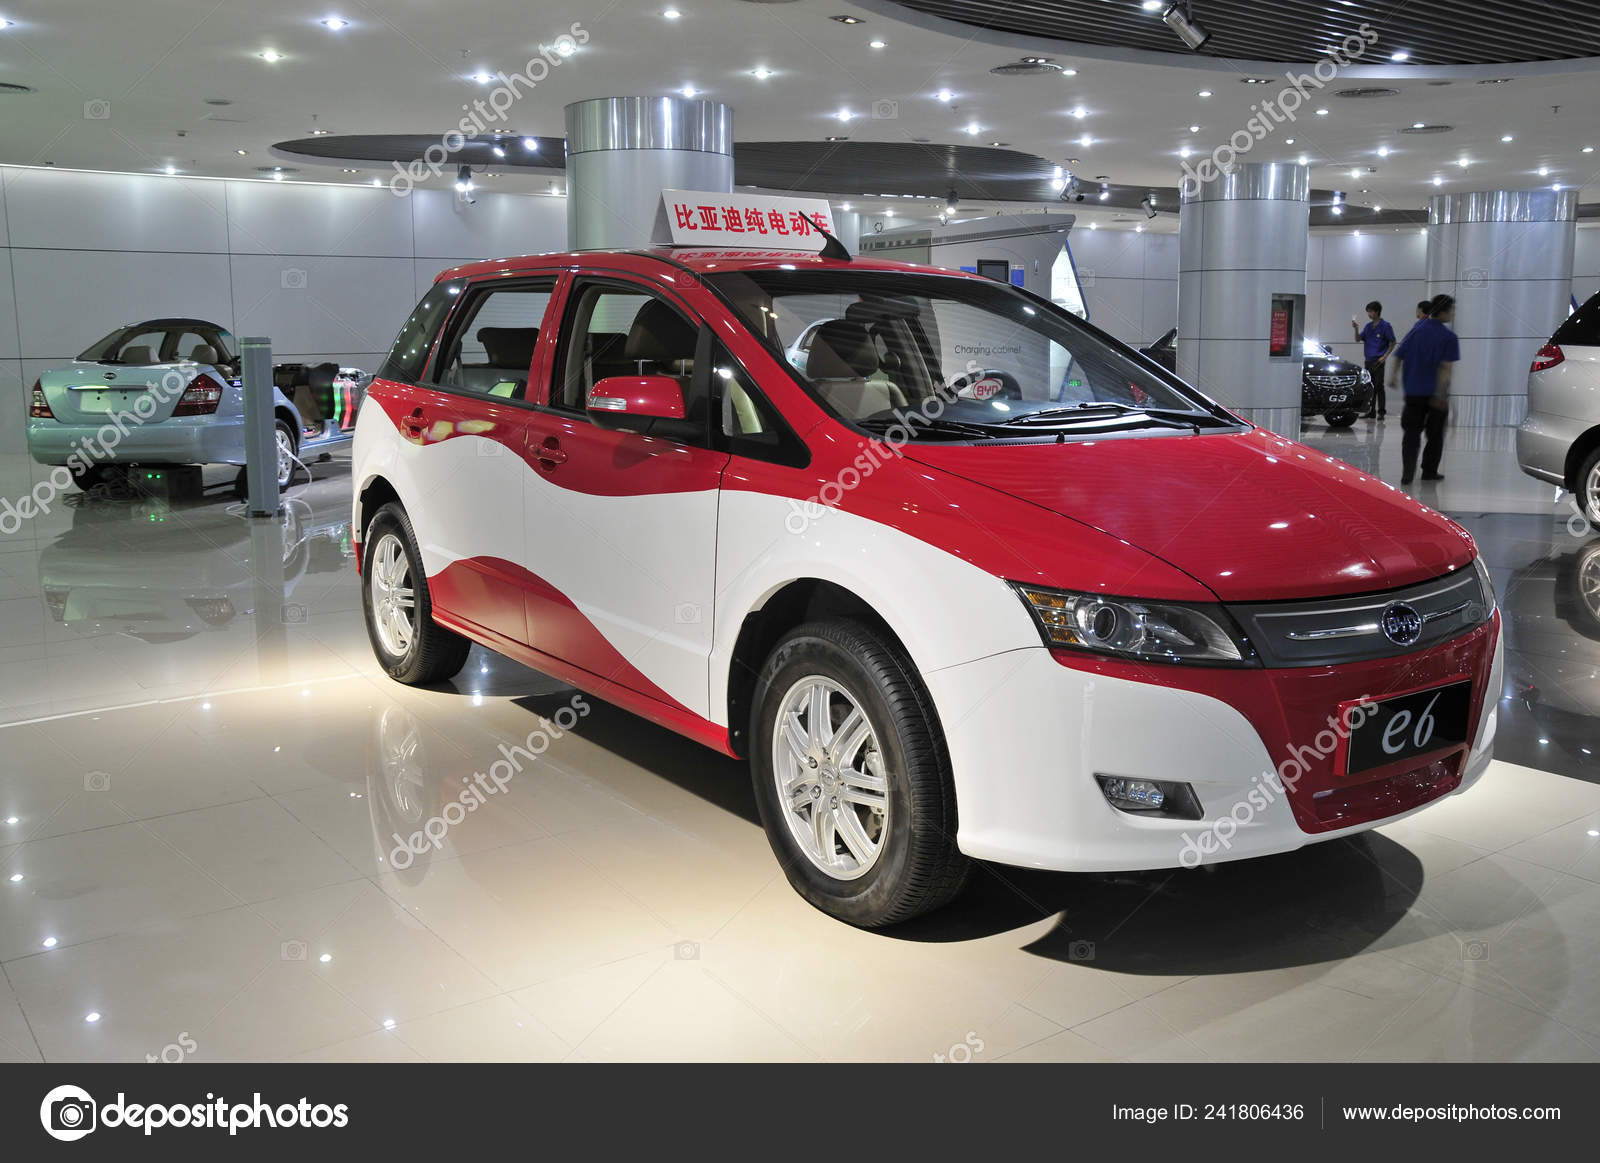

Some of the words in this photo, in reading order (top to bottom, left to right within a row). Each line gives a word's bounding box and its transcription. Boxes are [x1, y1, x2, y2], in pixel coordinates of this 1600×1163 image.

[674, 204, 831, 238] 比亚迪纯电动车
[954, 344, 991, 356] Charging
[992, 344, 1022, 355] cabinet
[1381, 691, 1442, 755] e6
